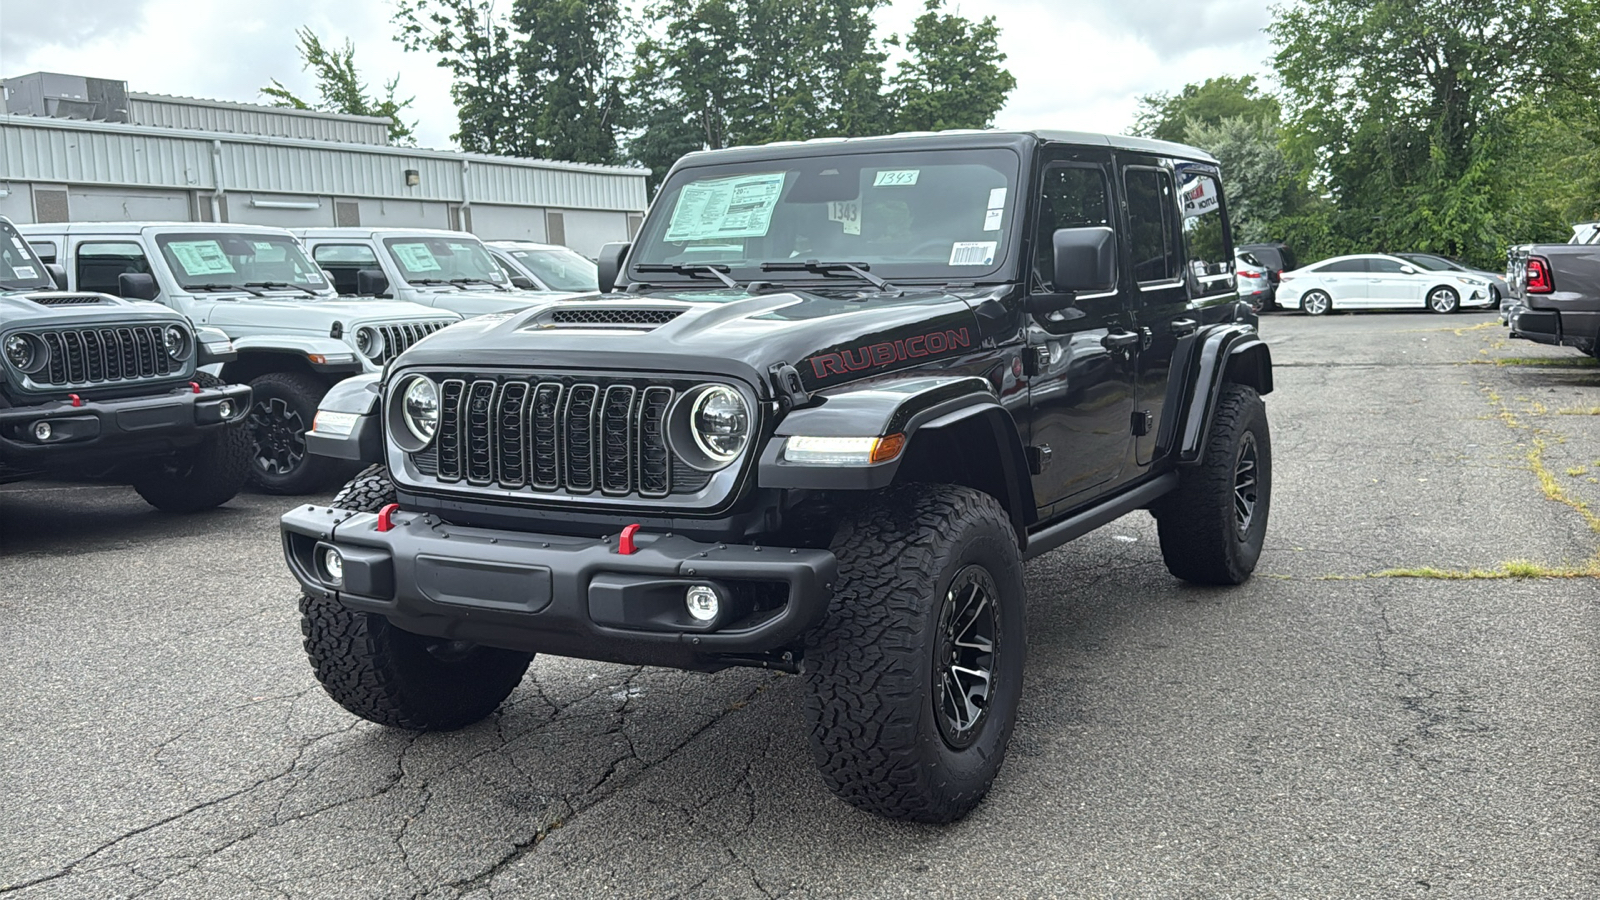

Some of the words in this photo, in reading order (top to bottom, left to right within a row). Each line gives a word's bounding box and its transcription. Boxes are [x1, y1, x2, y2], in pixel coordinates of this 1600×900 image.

[878, 171, 916, 185] 1343
[833, 201, 857, 222] 1343
[809, 326, 971, 379] RUBICON
